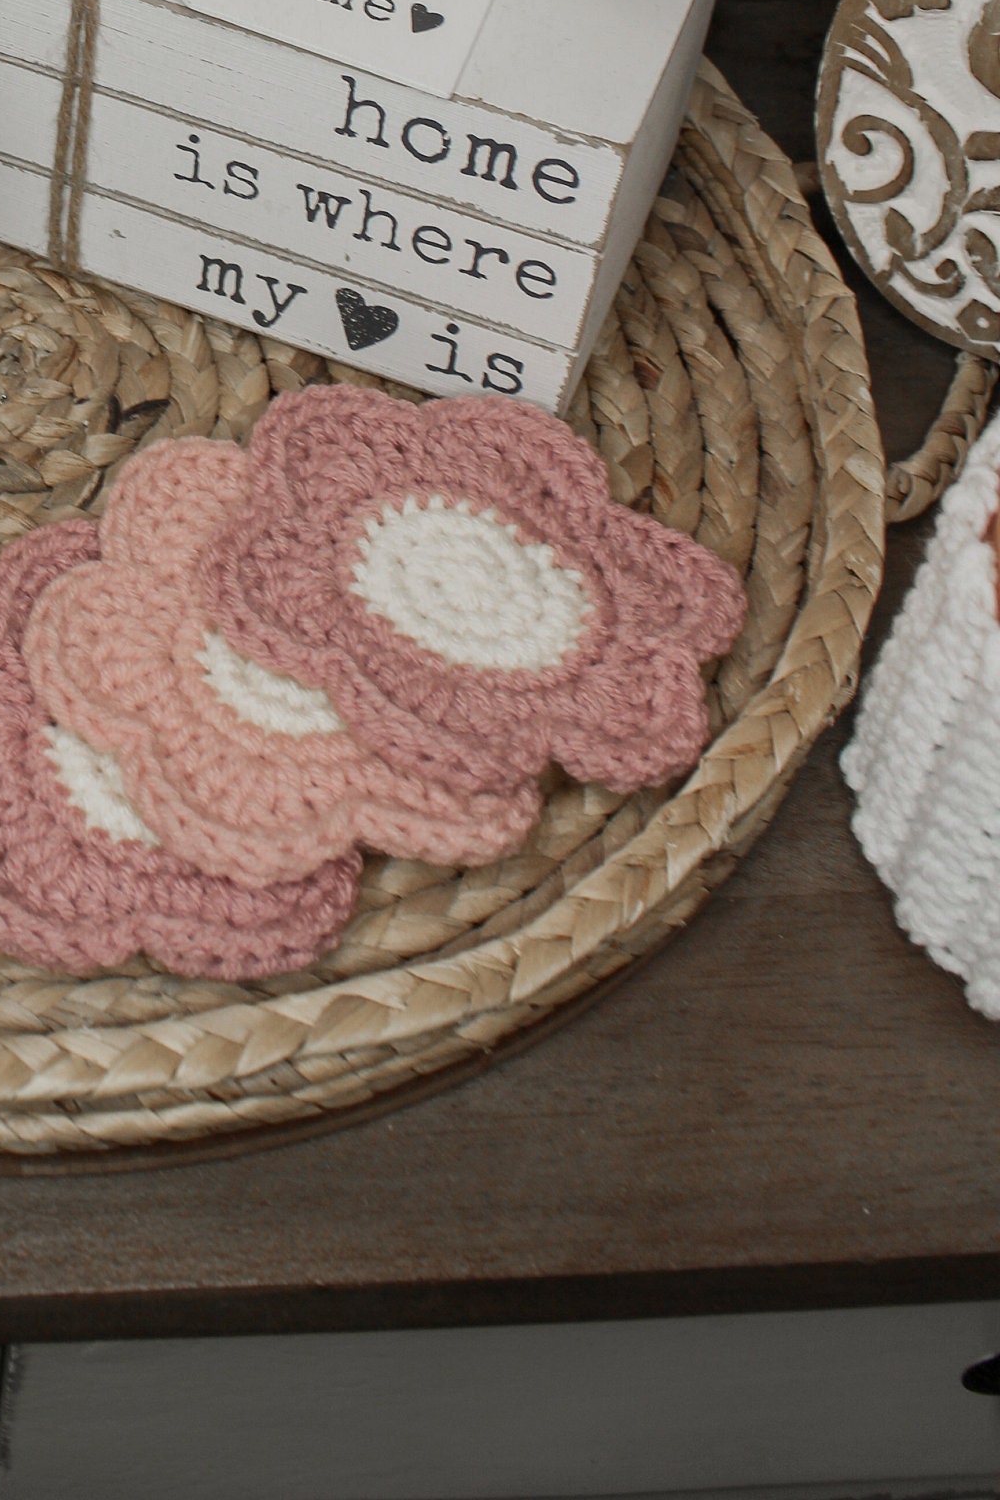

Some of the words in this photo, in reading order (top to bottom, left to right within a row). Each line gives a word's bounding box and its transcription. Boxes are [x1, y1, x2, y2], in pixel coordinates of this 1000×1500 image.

[334, 75, 580, 204] home
[173, 134, 260, 200] is
[296, 182, 557, 299] where
[196, 253, 308, 327] my
[424, 323, 525, 396] is
